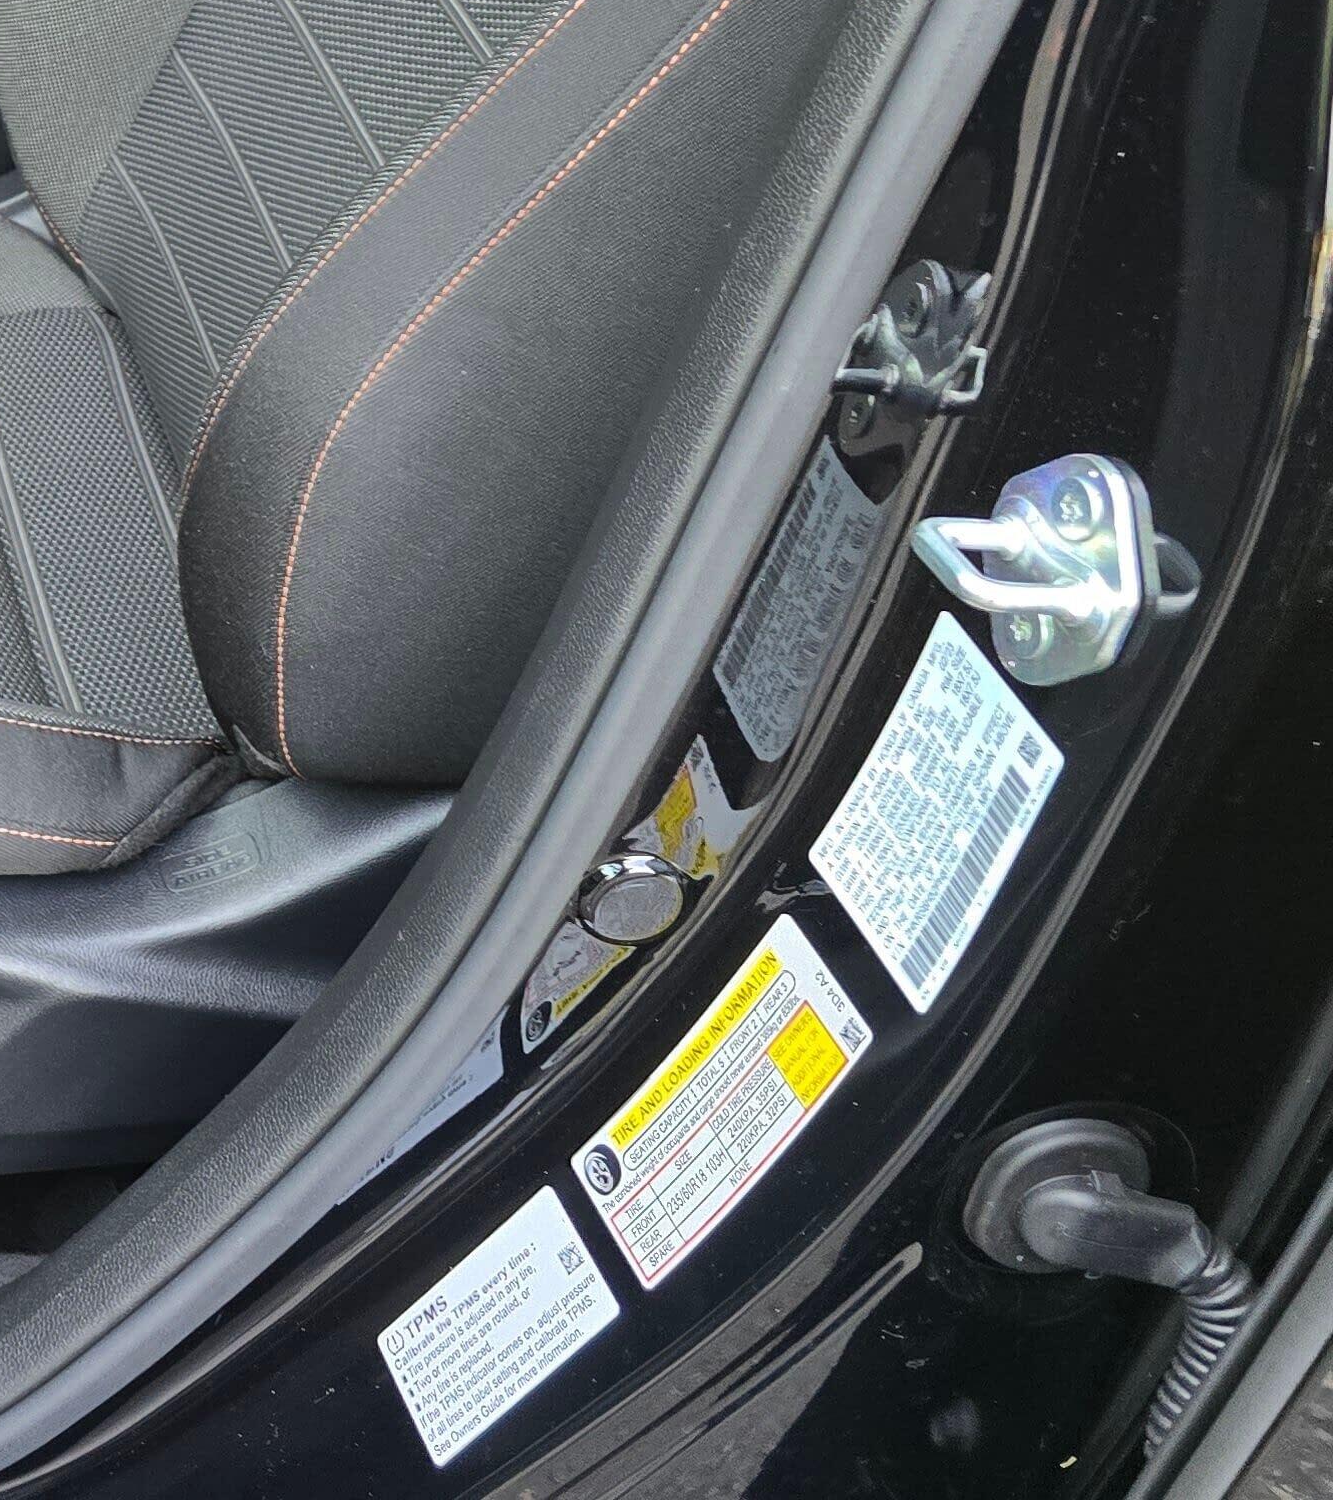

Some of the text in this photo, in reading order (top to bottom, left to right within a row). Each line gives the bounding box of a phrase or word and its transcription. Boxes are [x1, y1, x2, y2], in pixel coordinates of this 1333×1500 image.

[762, 981, 787, 1013] REAR 3
[814, 969, 845, 1012] 3D4 A2
[611, 952, 776, 1144] TIRE AND LOADING INFORMATION
[729, 1018, 758, 1053] FRONT 2
[695, 1065, 720, 1090] TOTAL
[711, 1057, 772, 1129] COLD TIRE PRESSURE
[727, 1077, 777, 1138] 240KPA, 35PSI
[629, 1094, 691, 1163] SEATING CAPACITY
[736, 1092, 787, 1153] 220KPA, 32PSI
[666, 1147, 726, 1215] 235/60R18 103H
[674, 1149, 692, 1170] SIZE
[728, 1158, 752, 1187] NONE
[624, 1198, 643, 1219] TIRE
[630, 1208, 656, 1237] FRONT
[639, 1228, 662, 1252] REAR
[648, 1239, 674, 1267] SPARE
[394, 1332, 435, 1370] Calibrate
[435, 1317, 452, 1334] the
[450, 1289, 480, 1318] TPMS
[481, 1266, 507, 1294] every
[507, 1248, 530, 1270] time
[405, 1295, 447, 1338] TPMS
[406, 1265, 536, 1378] Tire pressure is adjusted in any tire,
[412, 1286, 530, 1392] Two or more tires are rotated, or
[418, 1273, 595, 1429] If the TPMS indicator comes on, adjust pressure
[421, 1340, 494, 1407] Any tire is replaced.
[427, 1294, 596, 1442] of all tires to label setting and calibrate TPMS.
[433, 1328, 584, 1456] See Owners Guide for more information.
